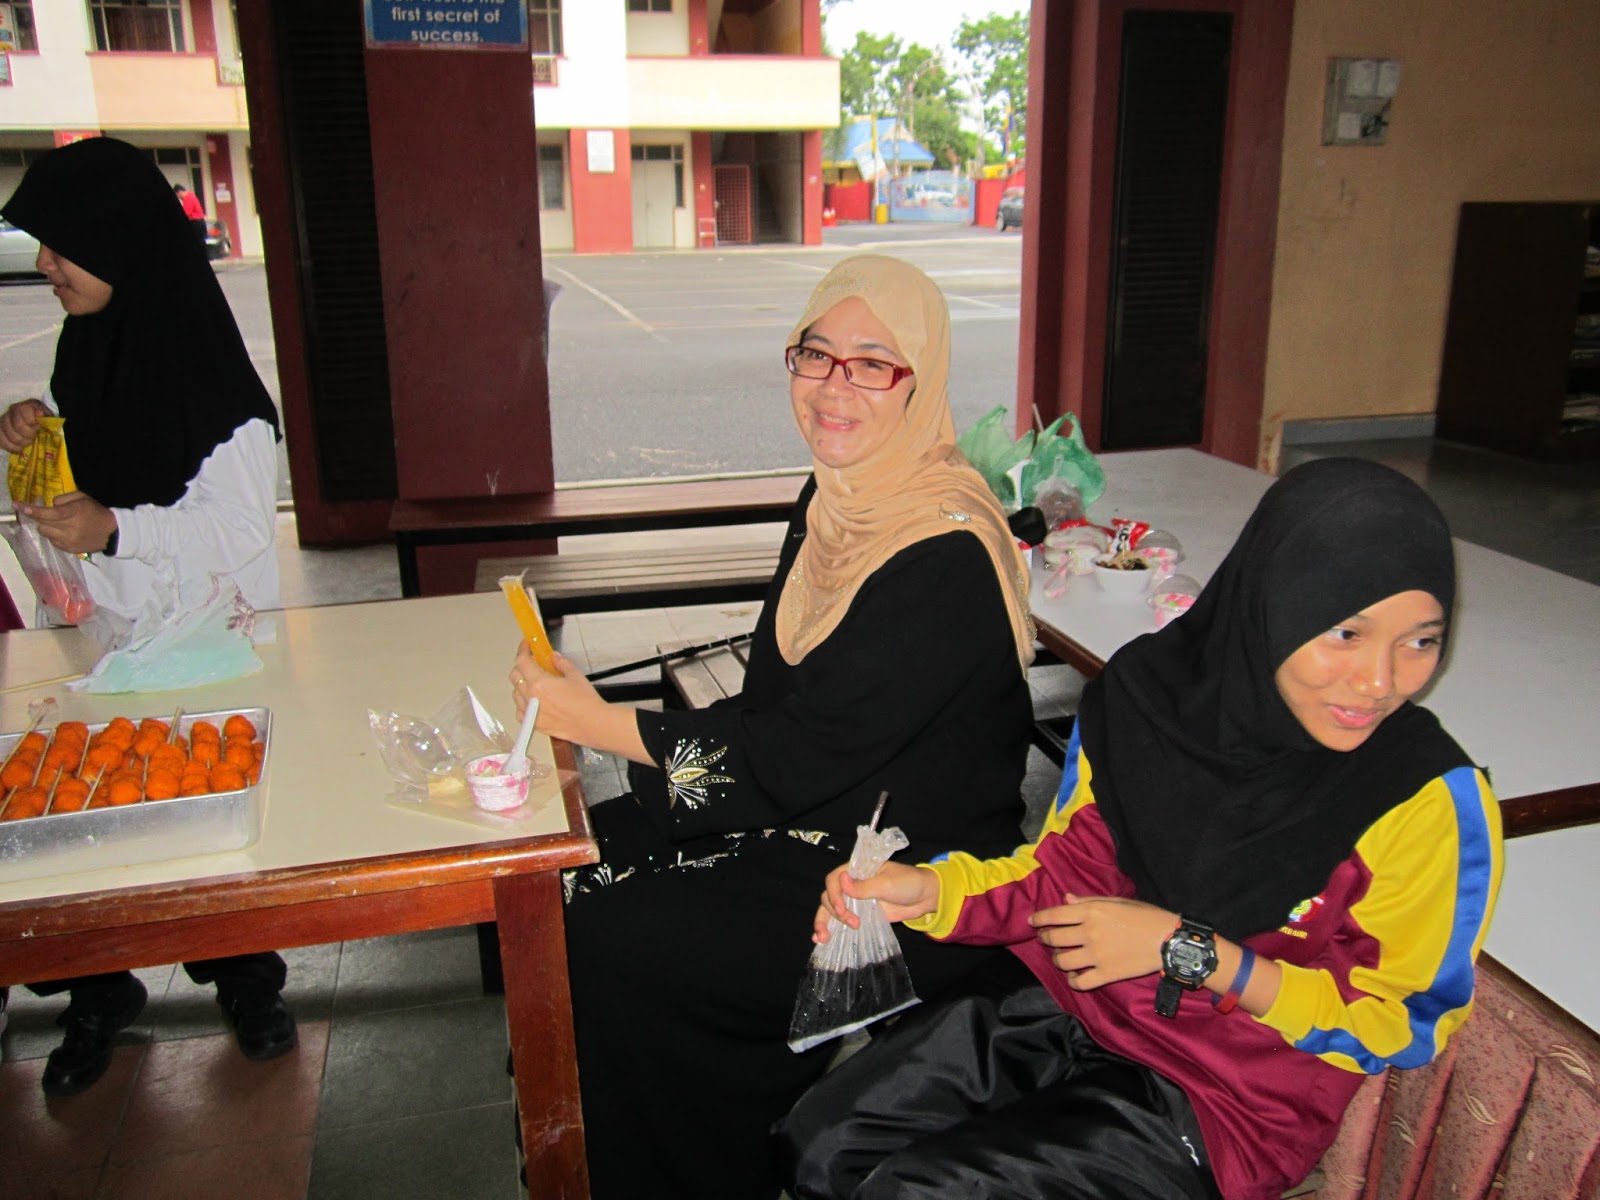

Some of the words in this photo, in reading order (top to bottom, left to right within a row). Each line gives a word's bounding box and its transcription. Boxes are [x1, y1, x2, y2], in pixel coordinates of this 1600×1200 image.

[392, 7, 420, 21] first
[426, 9, 479, 23] secret
[484, 9, 500, 23] of
[411, 30, 484, 42] success.
